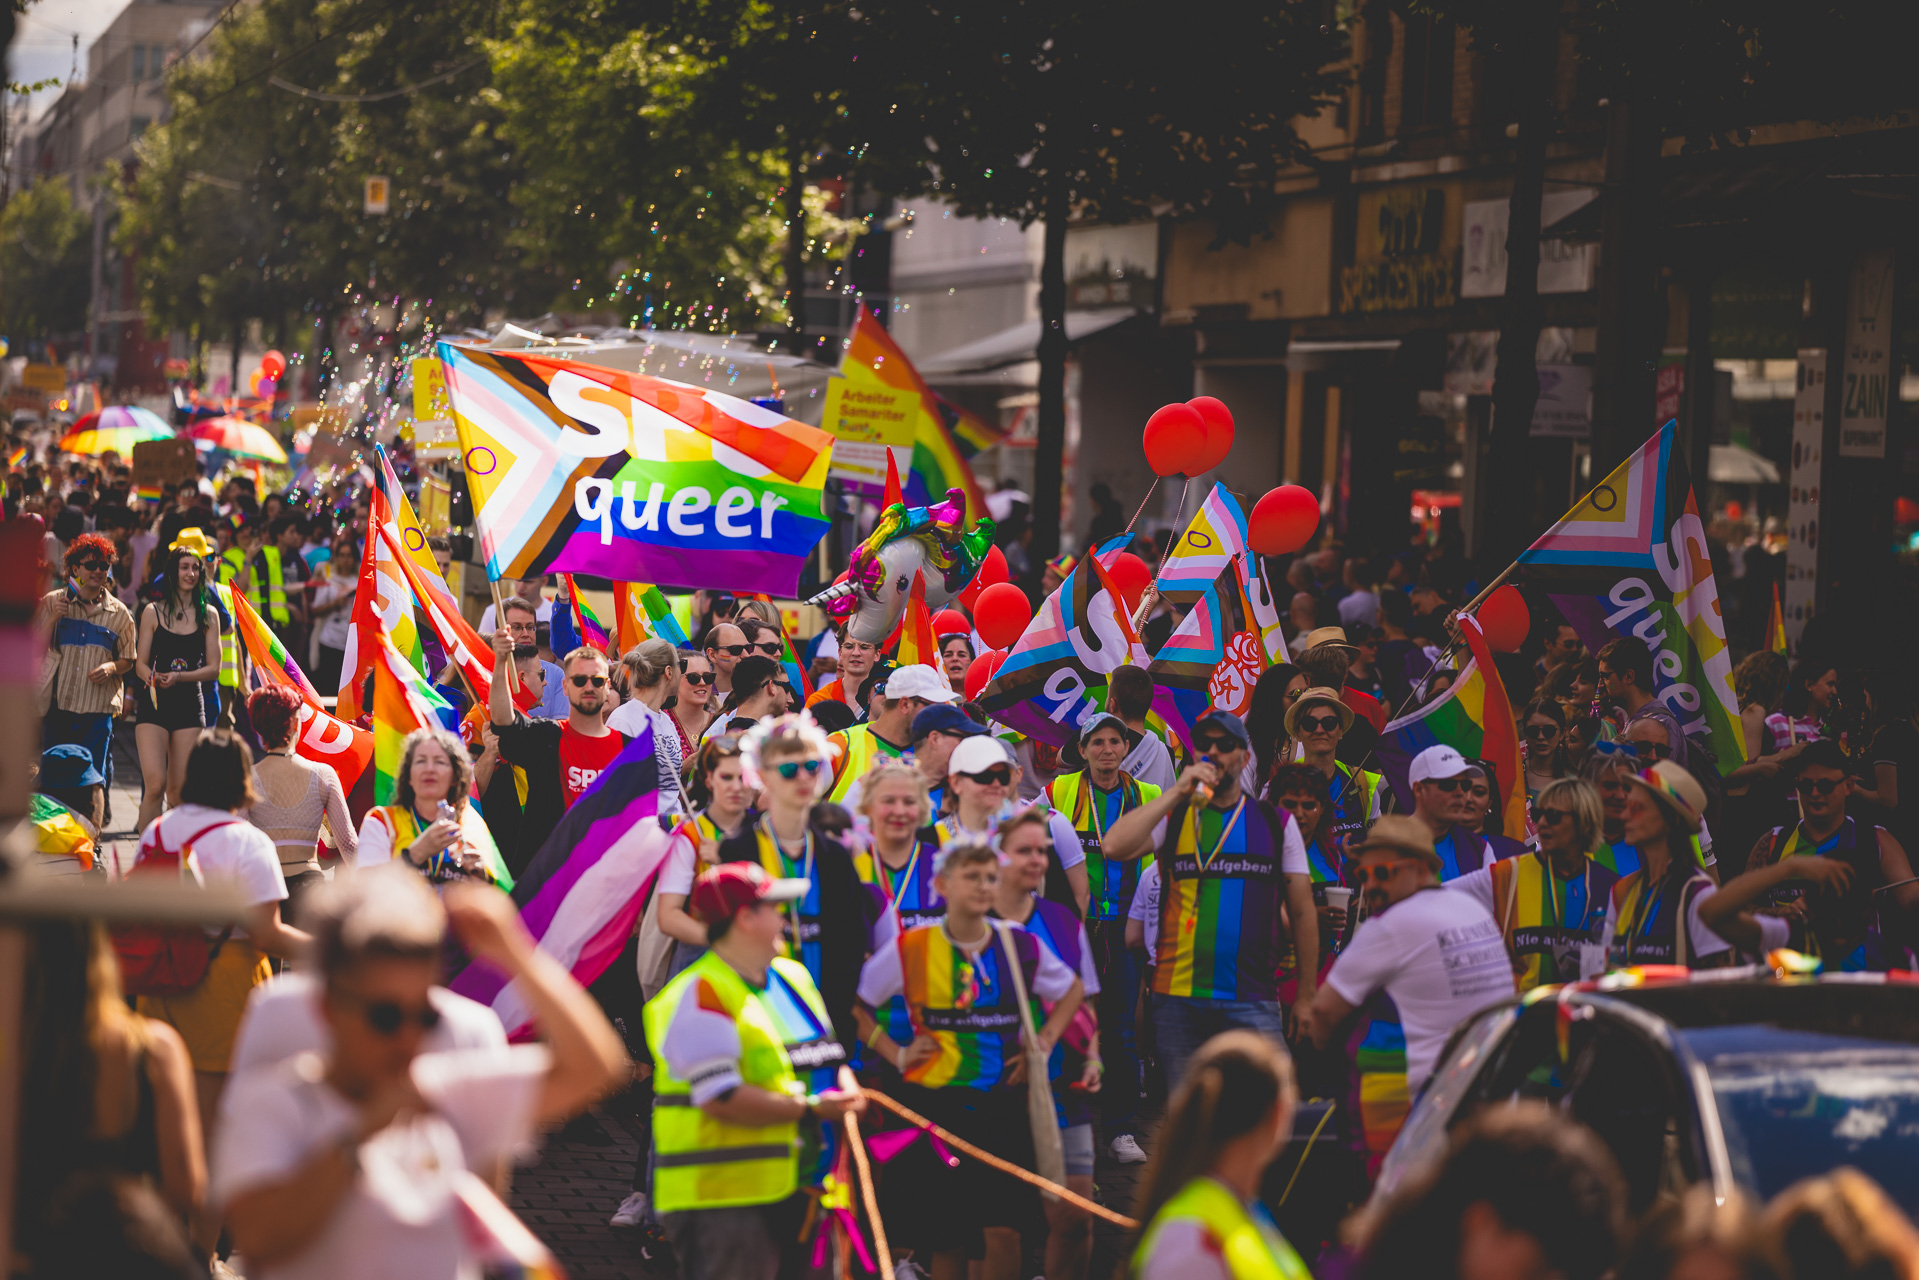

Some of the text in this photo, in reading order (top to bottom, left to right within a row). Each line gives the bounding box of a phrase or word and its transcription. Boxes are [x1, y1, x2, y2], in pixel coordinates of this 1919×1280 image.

[841, 390, 896, 405] Arbeiter
[1844, 373, 1886, 418] ZAIN
[838, 403, 905, 421] Samariter
[574, 476, 789, 546] queer
[1603, 577, 1712, 737] queer
[568, 765, 605, 788] SP
[1174, 860, 1196, 873] Nie
[1516, 933, 1539, 948] Nie
